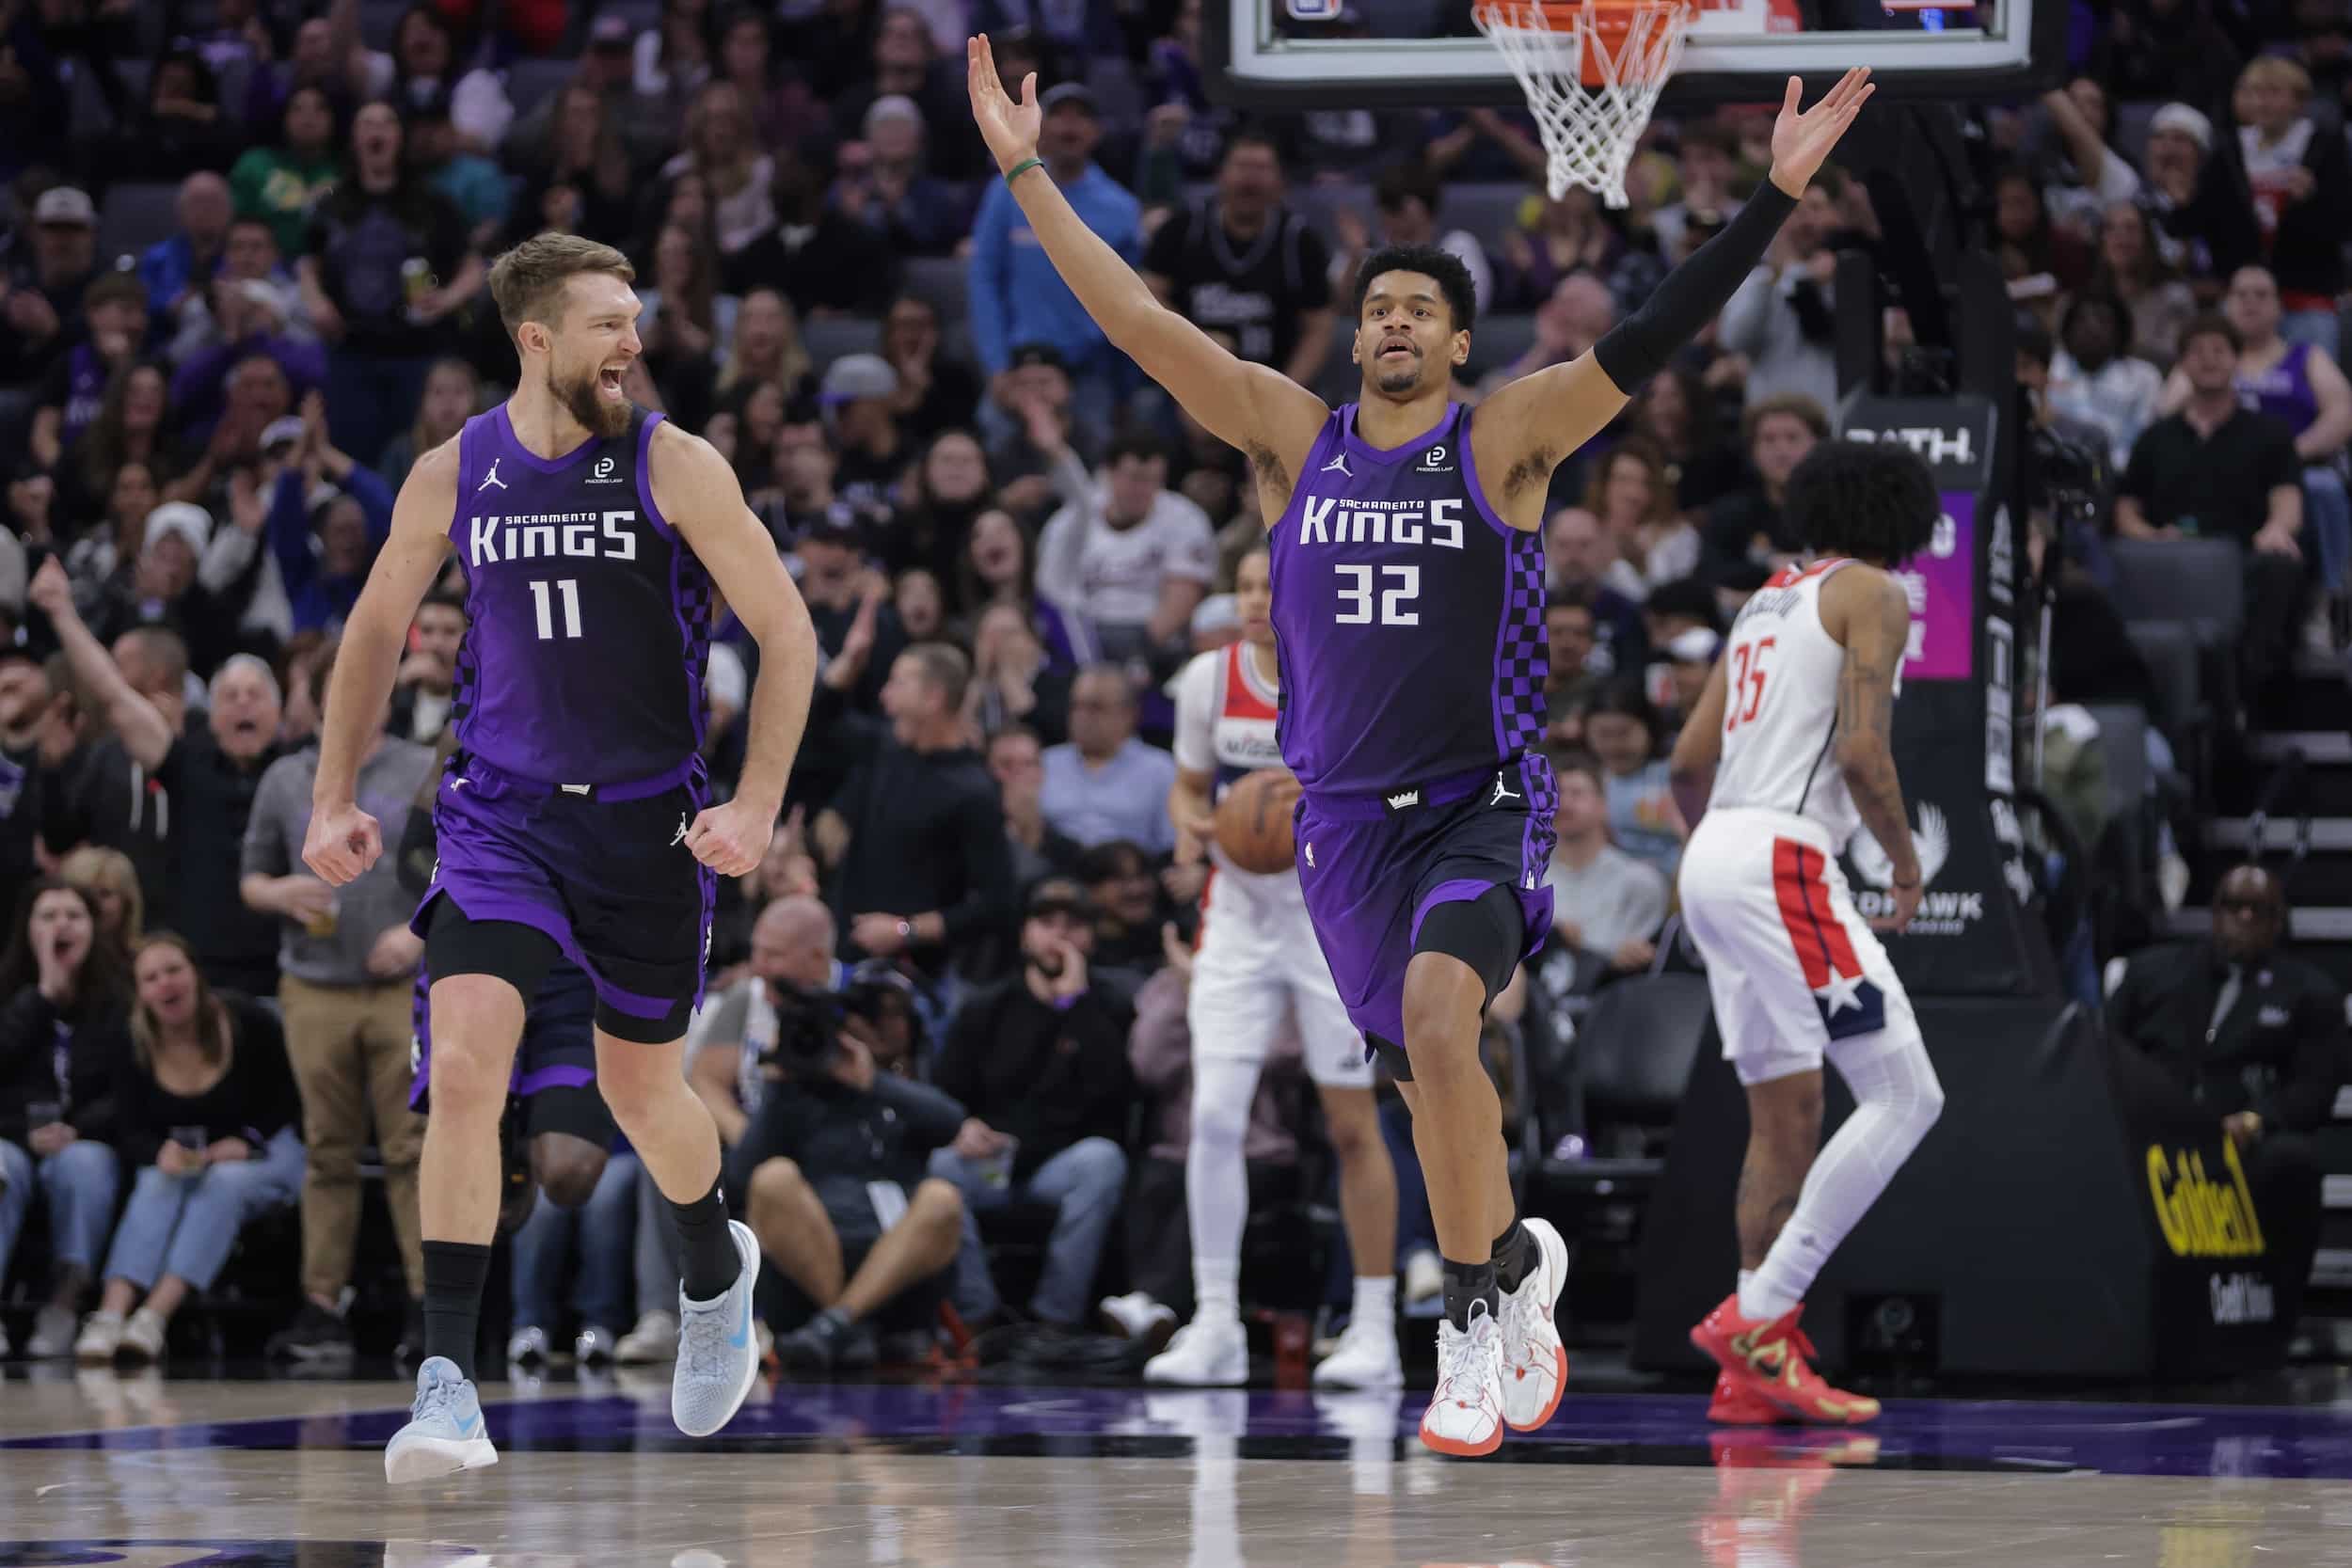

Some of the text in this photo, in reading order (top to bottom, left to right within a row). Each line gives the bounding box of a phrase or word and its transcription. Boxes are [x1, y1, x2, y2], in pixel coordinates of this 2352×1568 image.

[504, 512, 596, 525] SACRAMENTO
[1339, 499, 1424, 511] SACRAMENTO
[529, 579, 582, 640] 11
[1335, 564, 1420, 626] 32
[1726, 636, 1776, 732] 35
